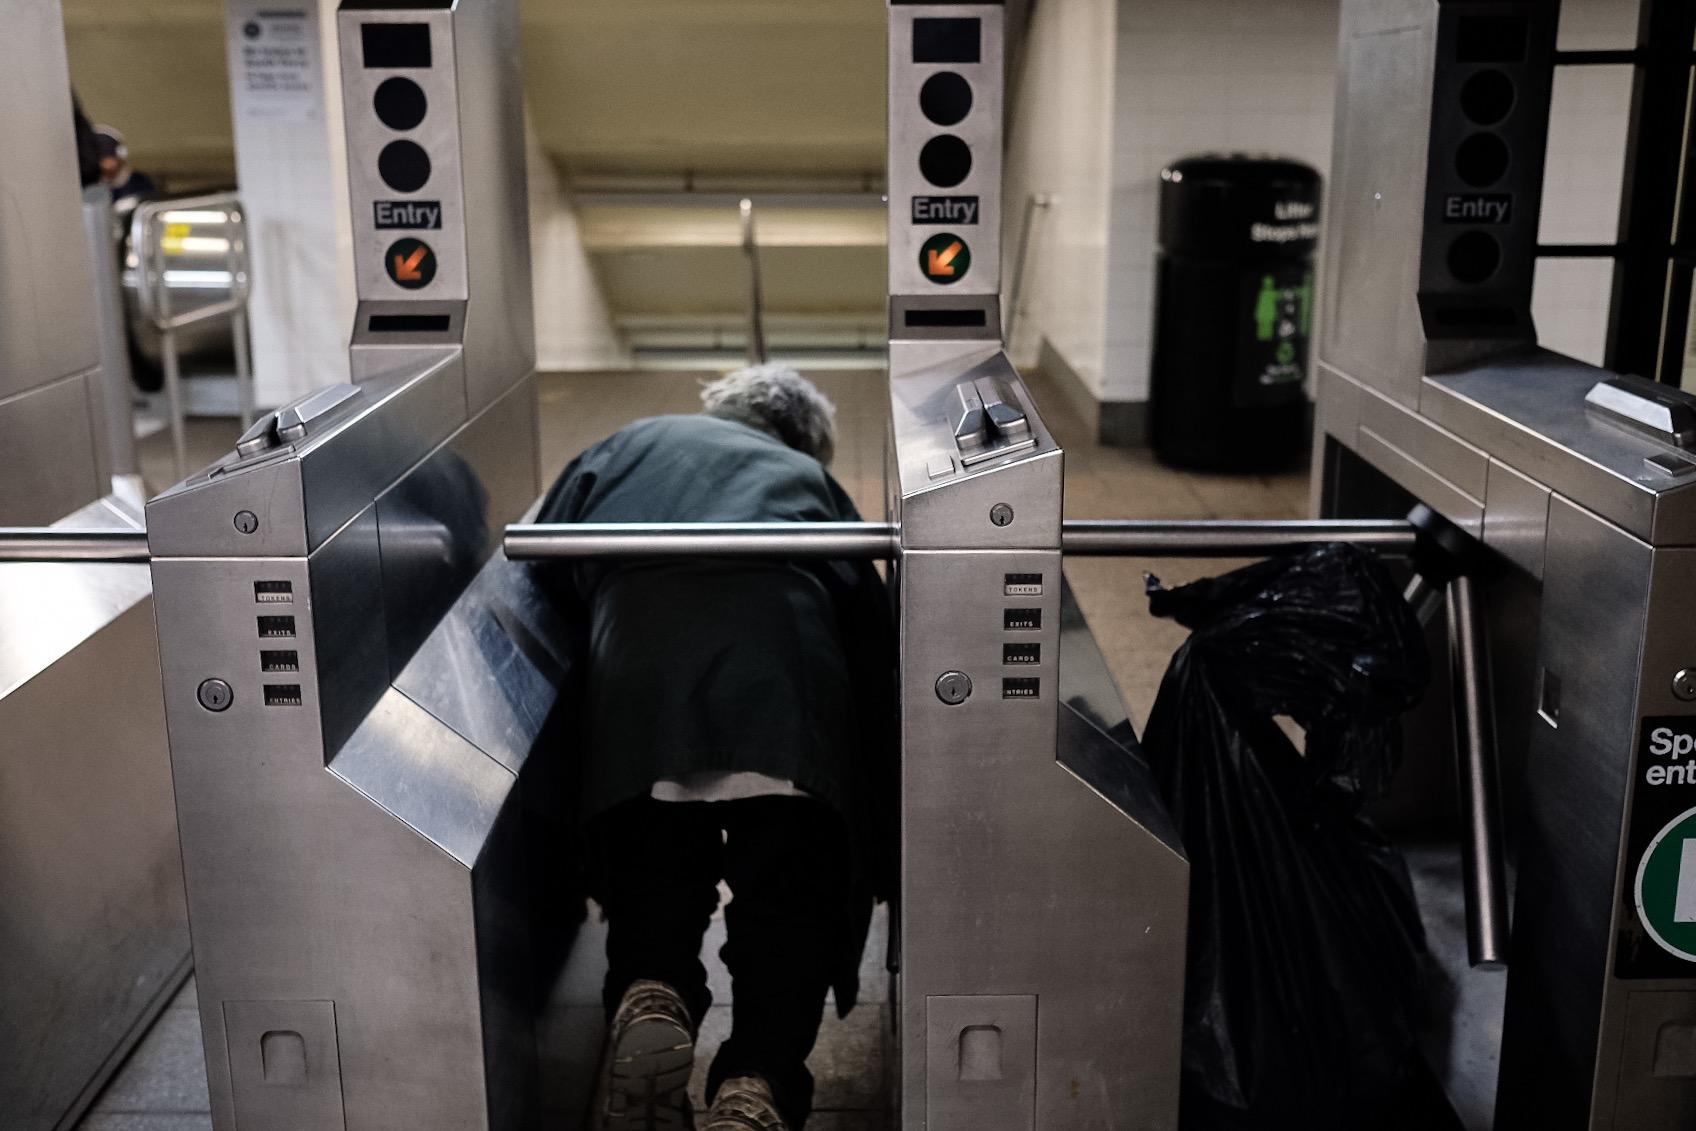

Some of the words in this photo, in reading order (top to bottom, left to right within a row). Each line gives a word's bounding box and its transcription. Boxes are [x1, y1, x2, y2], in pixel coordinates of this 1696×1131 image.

[376, 202, 439, 229] Entry
[913, 197, 977, 224] Entry
[1446, 196, 1509, 223] Entry
[1649, 726, 1696, 760] Sp
